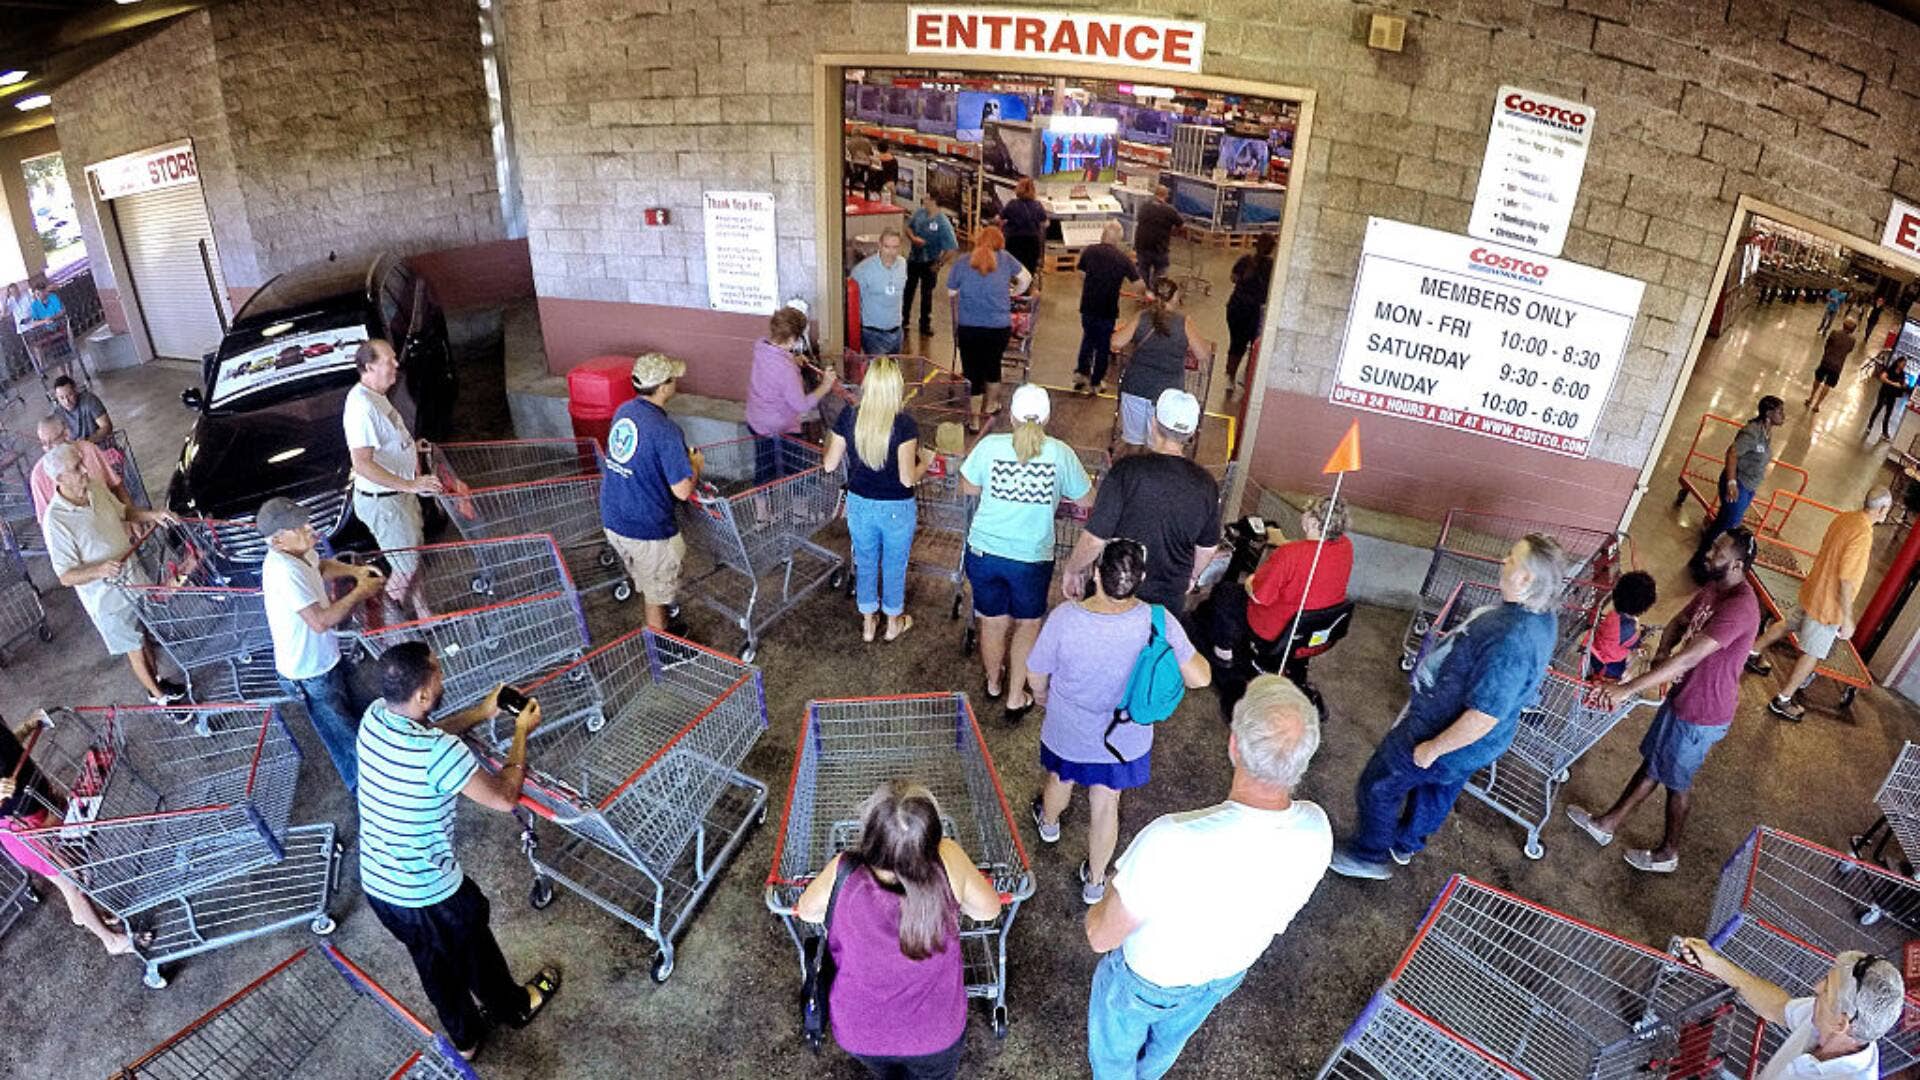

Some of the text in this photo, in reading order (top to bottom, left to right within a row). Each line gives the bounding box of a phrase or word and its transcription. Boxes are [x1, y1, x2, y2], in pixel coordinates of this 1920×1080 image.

[916, 15, 1193, 64] ENTRANCE
[1504, 94, 1586, 126] COSTCO
[1895, 213, 1920, 253] E
[1470, 247, 1549, 278] COSTCO
[1420, 276, 1577, 330] MEMBERS ONLY
[1375, 301, 1423, 328] MON
[1438, 316, 1471, 339] FRI
[1500, 330, 1548, 357] 10:00
[1562, 346, 1600, 371] 8:30
[1367, 333, 1471, 371] SATURDAY
[1499, 363, 1538, 388] 9:30
[1551, 376, 1591, 401] 6:00
[1334, 387, 1587, 454] OPEN 24 HOURS A DAY AT WWW.COSTCO.COM
[1360, 365, 1439, 397] SUNDAY
[1481, 391, 1528, 418] 10:00
[1542, 405, 1580, 430] 6:00
